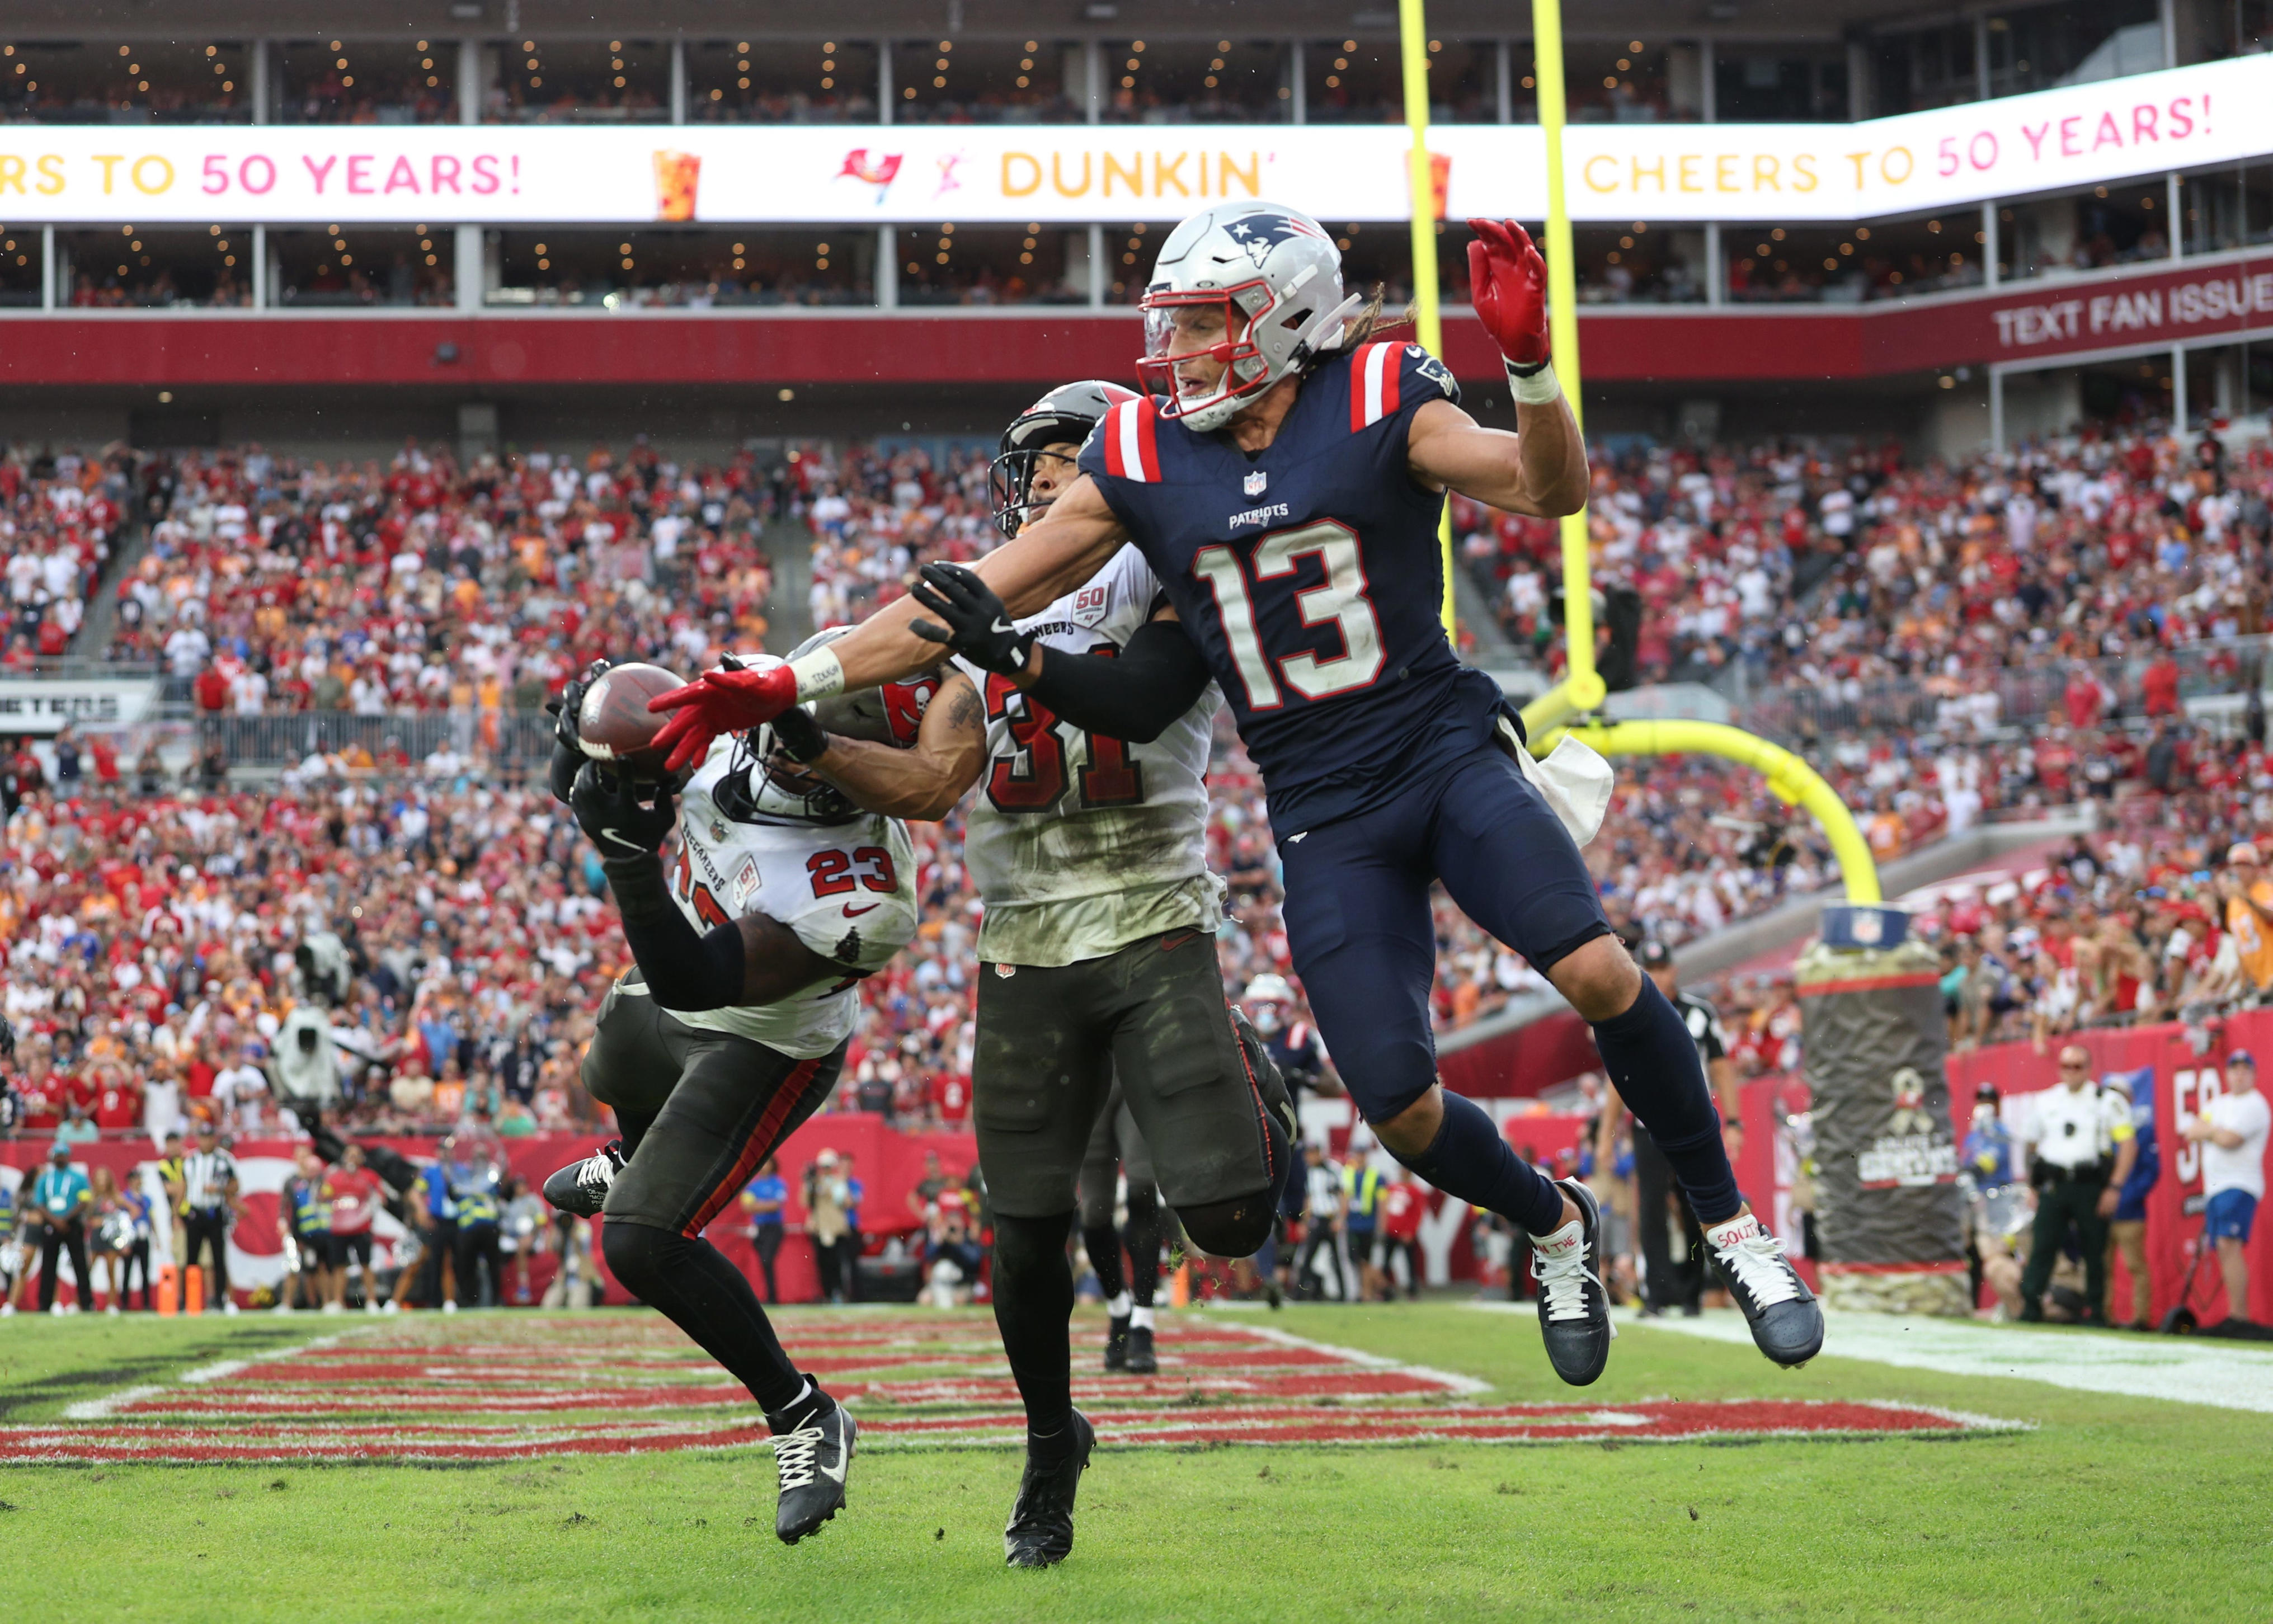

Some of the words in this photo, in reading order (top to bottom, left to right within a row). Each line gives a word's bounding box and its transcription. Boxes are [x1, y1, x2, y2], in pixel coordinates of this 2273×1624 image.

[1583, 154, 1819, 195] CHEERS
[1845, 145, 1914, 191] TO
[1939, 131, 1998, 177] 50
[2021, 94, 2212, 162] YEARS!
[0, 154, 66, 196] RS
[91, 154, 175, 196] TO
[202, 154, 277, 195] 50
[302, 154, 520, 195] YEARS!
[1992, 300, 2082, 346] TEXT
[2090, 289, 2163, 333] FAN
[1229, 503, 1289, 530] PATRIOTS
[1076, 587, 1104, 610] 50
[1192, 517, 1387, 712] 13
[806, 846, 898, 899] 23
[1550, 1234, 1576, 1253] THE
